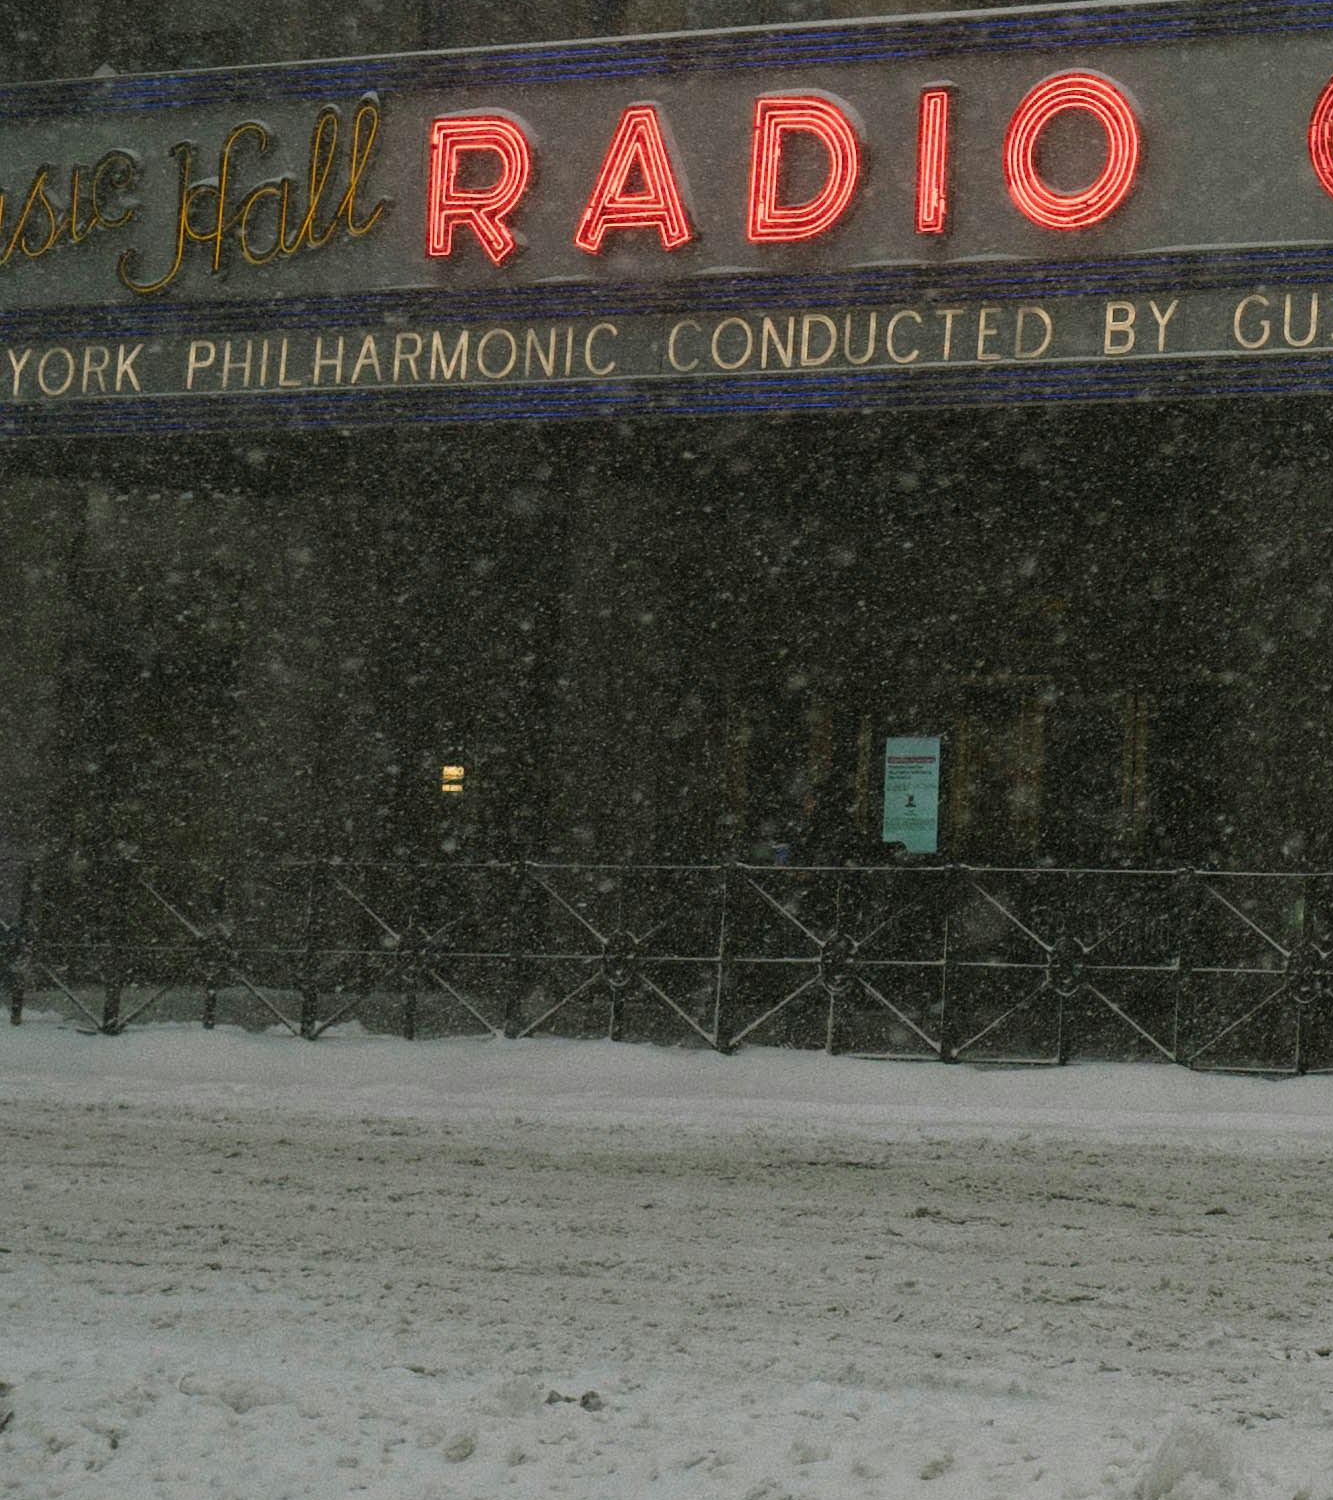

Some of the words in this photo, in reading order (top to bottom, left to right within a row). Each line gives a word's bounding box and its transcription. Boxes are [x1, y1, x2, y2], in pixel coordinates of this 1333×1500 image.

[0, 146, 139, 264] sic
[118, 93, 390, 294] Hall
[426, 70, 1142, 267] RADIO
[8, 343, 144, 397] YORK
[186, 322, 619, 391] PHILHARMONIC
[668, 306, 1054, 370] CONDUCTED
[1103, 299, 1181, 355] BY
